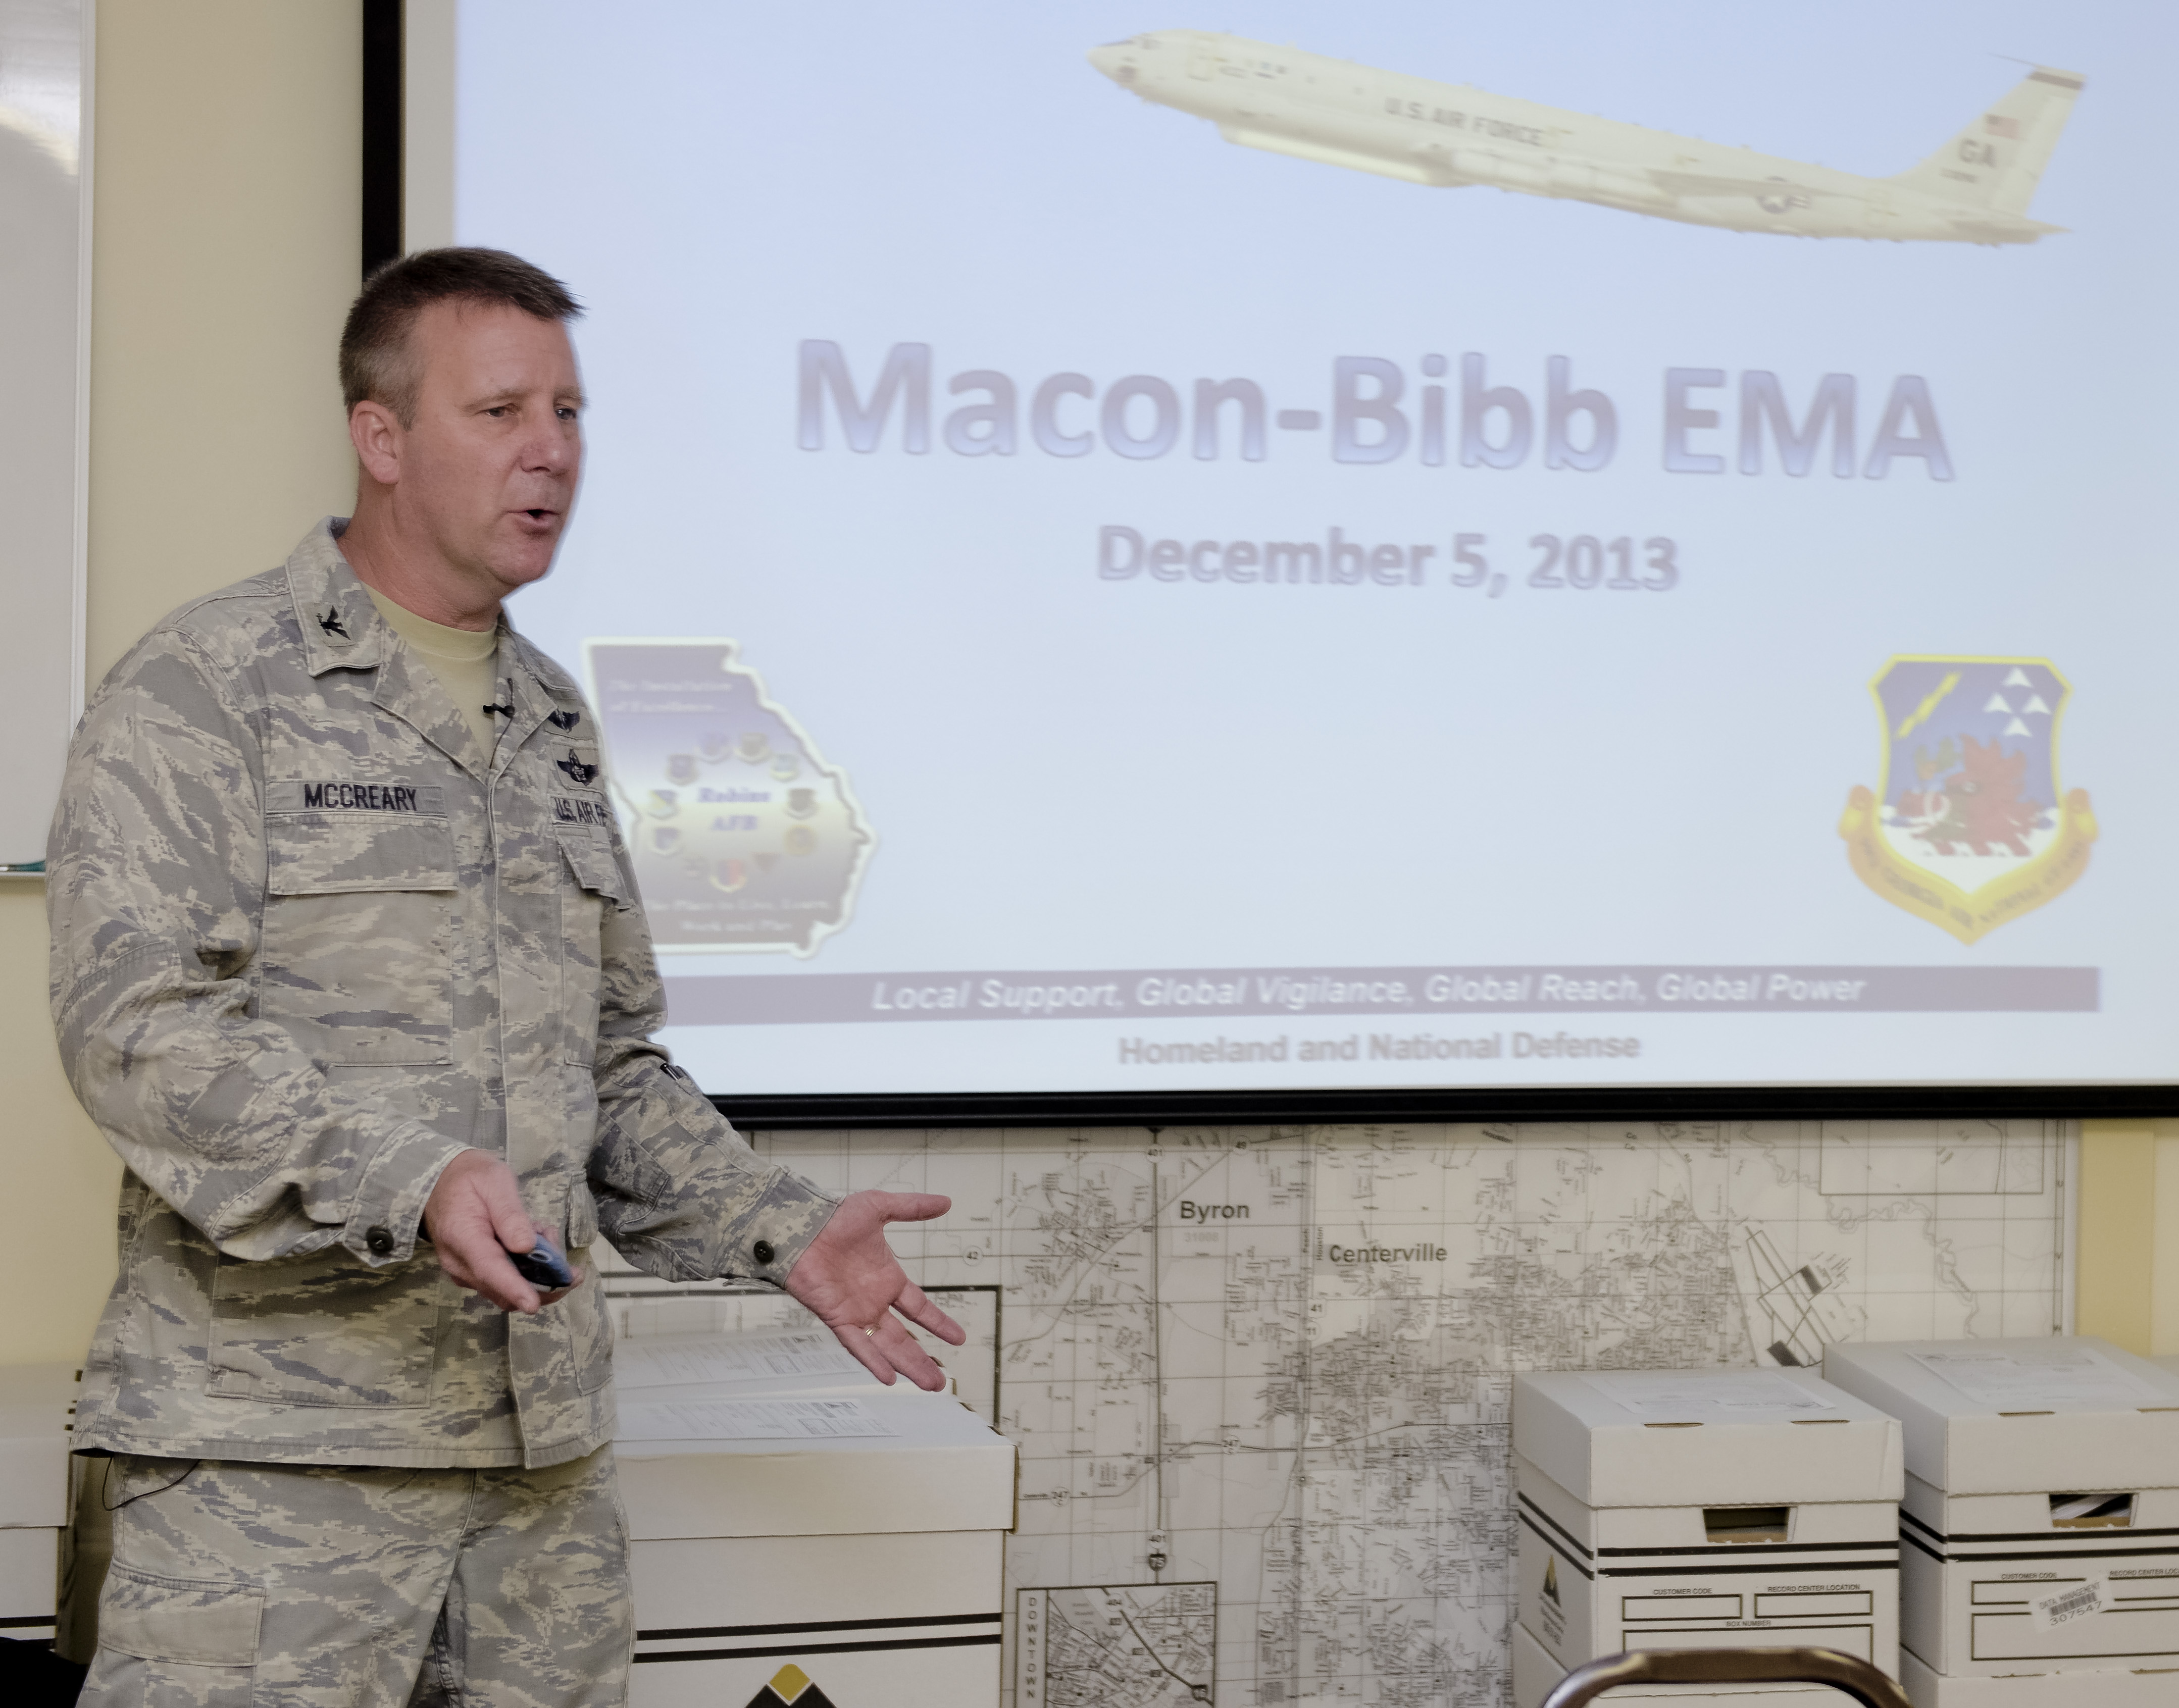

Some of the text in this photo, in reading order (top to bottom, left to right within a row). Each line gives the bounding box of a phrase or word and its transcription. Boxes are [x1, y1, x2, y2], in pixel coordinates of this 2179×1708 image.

[1471, 116, 1543, 146] FORCE
[1957, 137, 1996, 170] GA
[796, 338, 1956, 482] Macon-Bibb EMA
[1097, 525, 1680, 599] December 5, 2013
[304, 783, 418, 812] MCCREARY
[576, 800, 598, 824] AIR
[872, 979, 971, 1010] Local
[977, 979, 1125, 1014] Support,
[1135, 977, 1245, 1007] Global
[1424, 974, 1532, 1003] Global
[1656, 972, 1759, 1002] Global
[1765, 973, 1867, 1002] Power
[1118, 1031, 1641, 1065] Homeland and National Defense
[1180, 1201, 1250, 1224] Byron
[967, 1251, 979, 1260] 42
[1329, 1243, 1448, 1263] Centerville
[2039, 1581, 2100, 1610] DATA MANAGEMENT
[2050, 1601, 2102, 1626] 307547
[1027, 1596, 1038, 1698] DOWNTOWN
